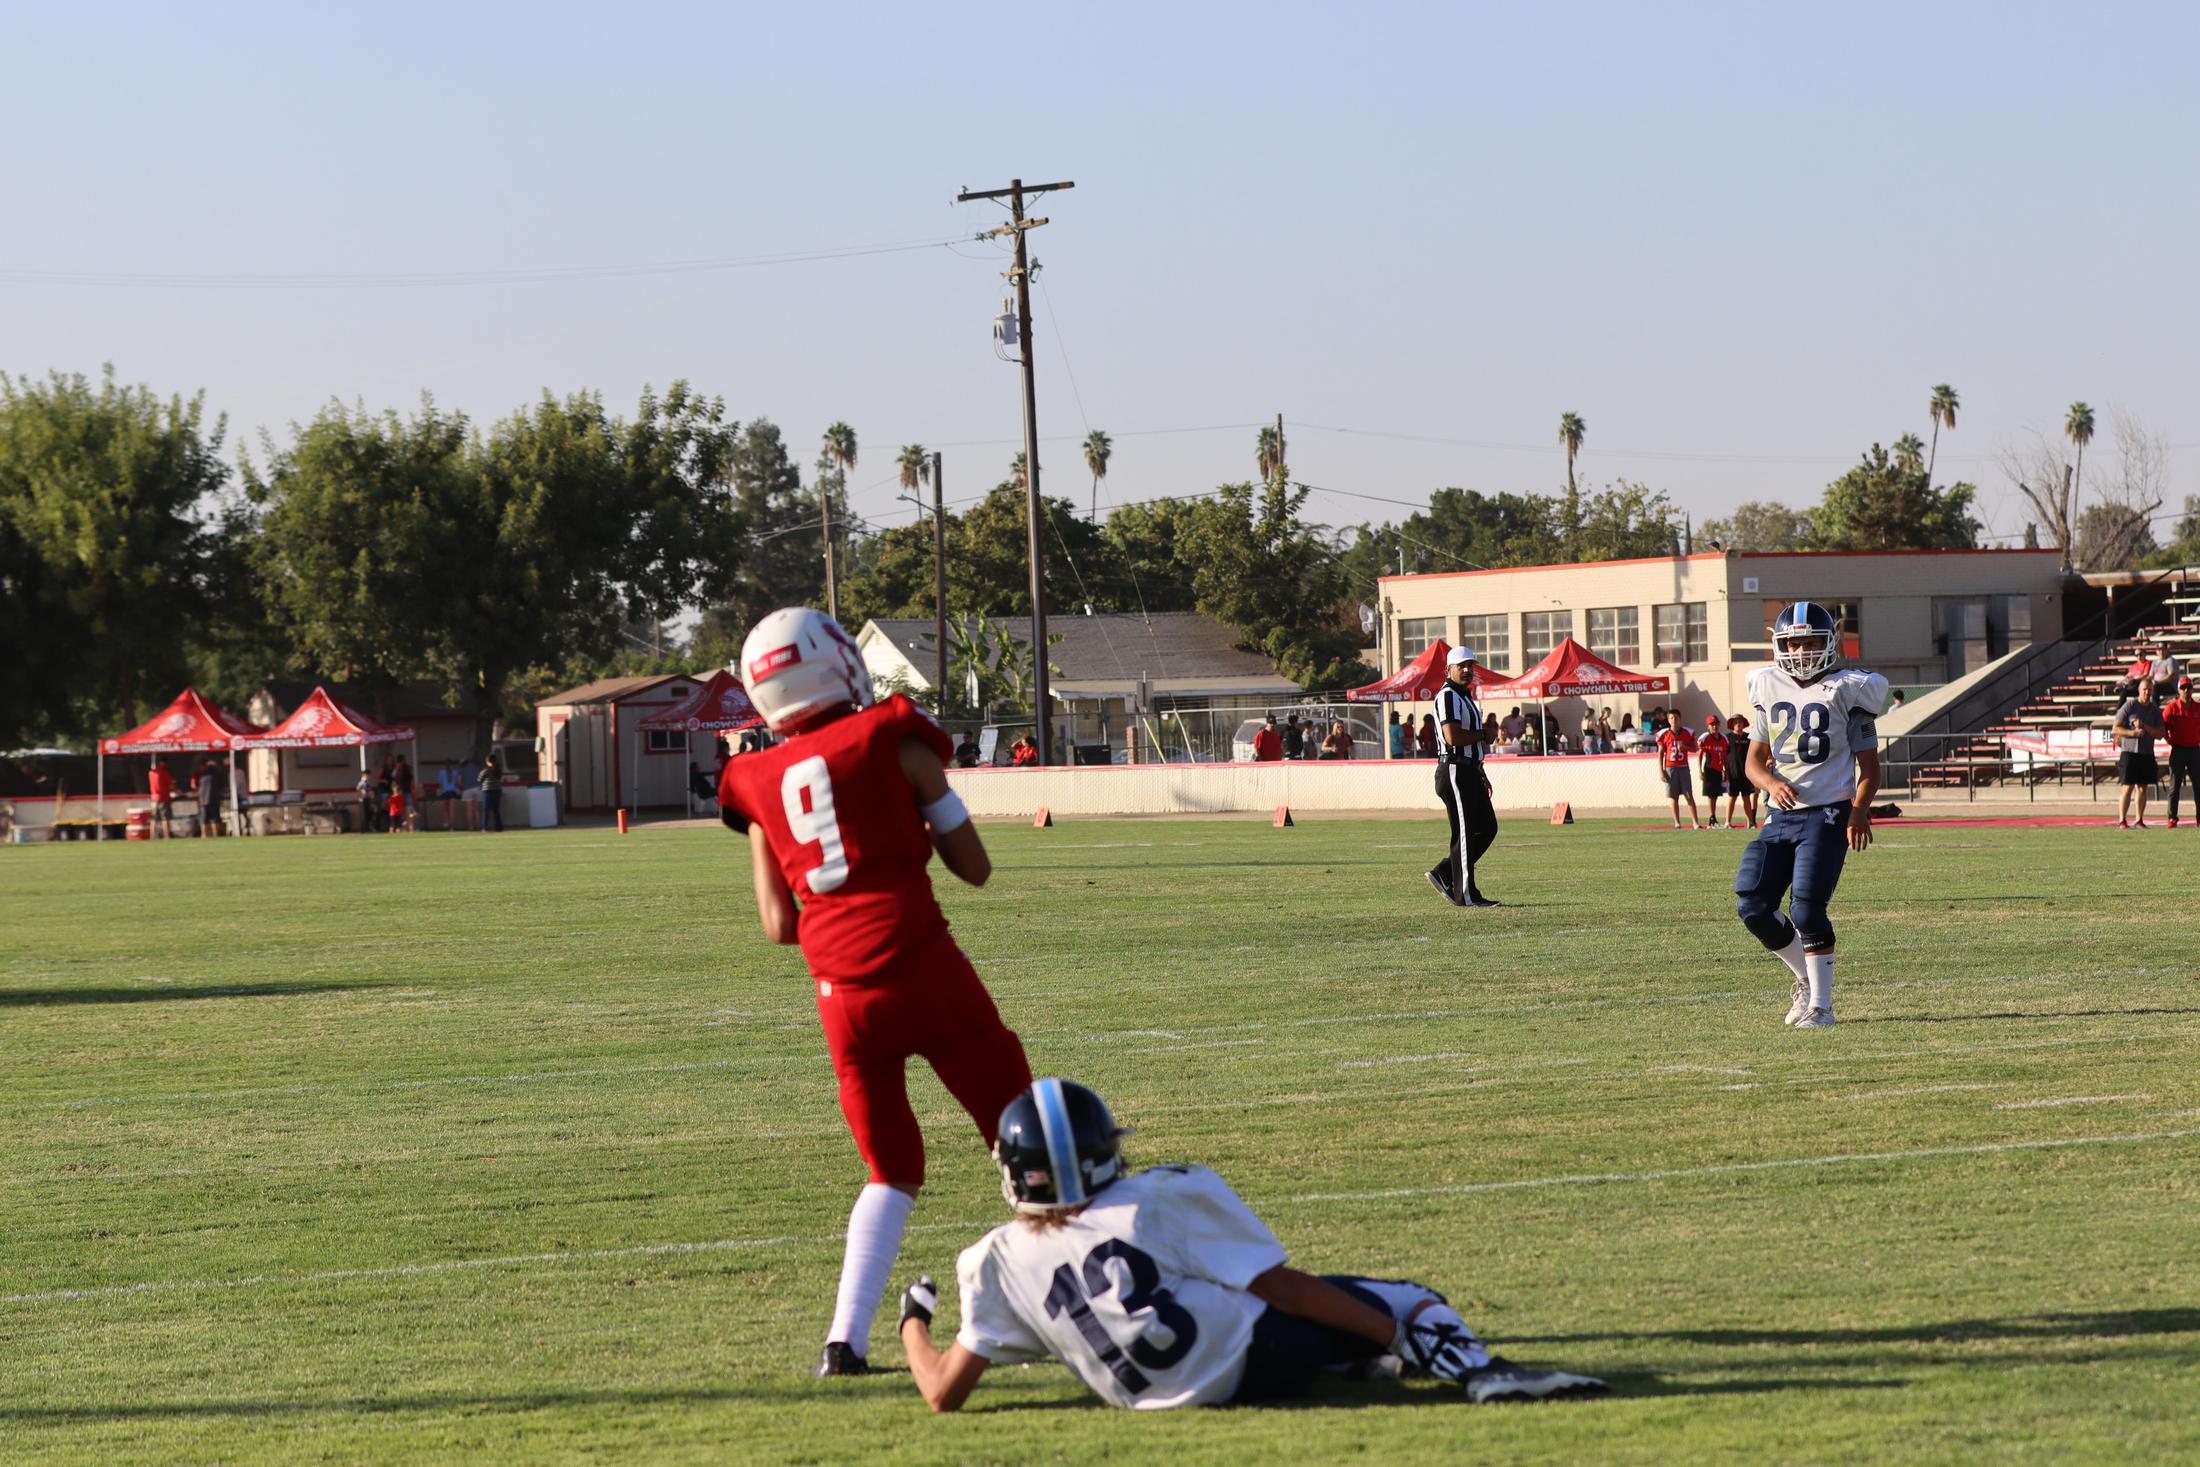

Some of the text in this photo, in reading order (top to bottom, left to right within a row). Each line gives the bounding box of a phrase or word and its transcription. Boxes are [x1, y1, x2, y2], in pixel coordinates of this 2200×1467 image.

[1564, 682, 1648, 695] CHOWCHILLA TRIBE
[702, 720, 764, 729] CHOWCHIA
[1770, 701, 1830, 764] 28
[781, 755, 849, 895] 9
[1044, 1237, 1198, 1395] 13
